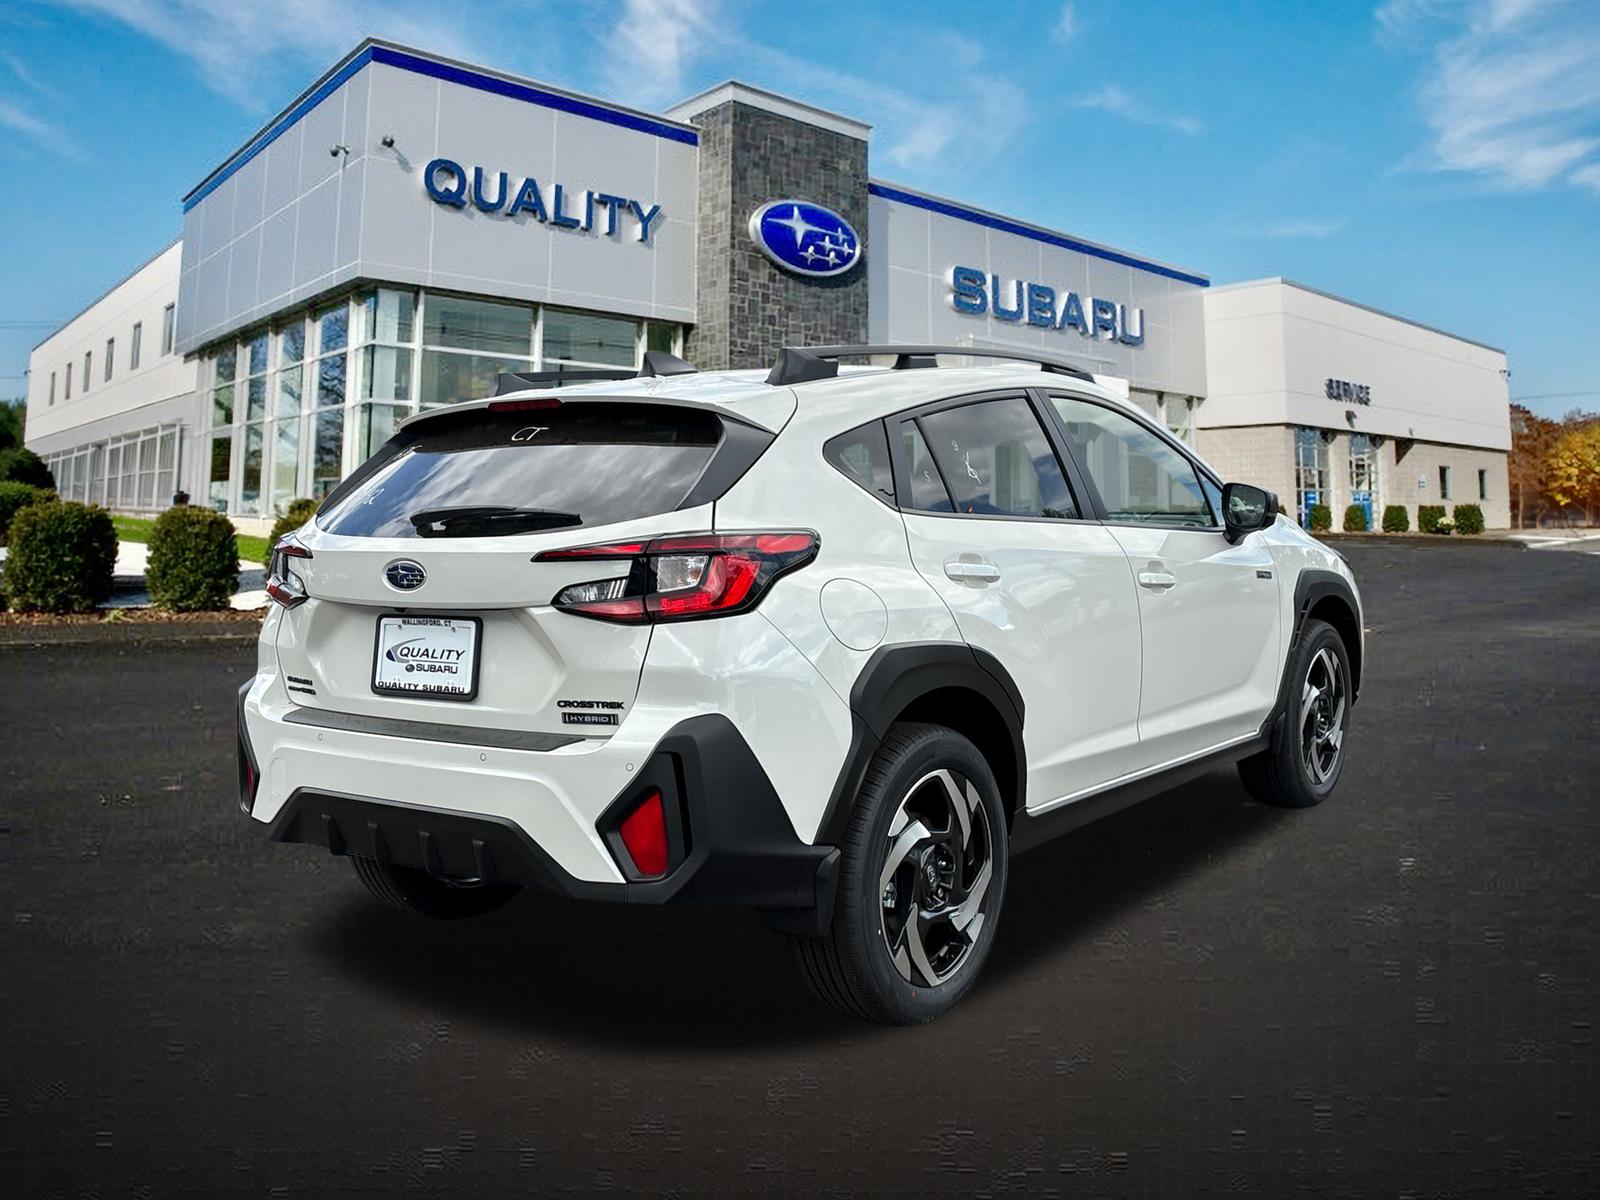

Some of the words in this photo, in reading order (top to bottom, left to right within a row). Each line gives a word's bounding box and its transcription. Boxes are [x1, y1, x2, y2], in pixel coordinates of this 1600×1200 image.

[424, 158, 661, 242] QUALITY
[951, 265, 1144, 346] SUBARU
[399, 647, 465, 660] QUALITY
[416, 664, 458, 674] SUBARU
[378, 681, 419, 690] QUALITY
[422, 684, 465, 694] SUBARU
[557, 700, 625, 709] CROSSTREK
[570, 715, 609, 723] HYBRID
